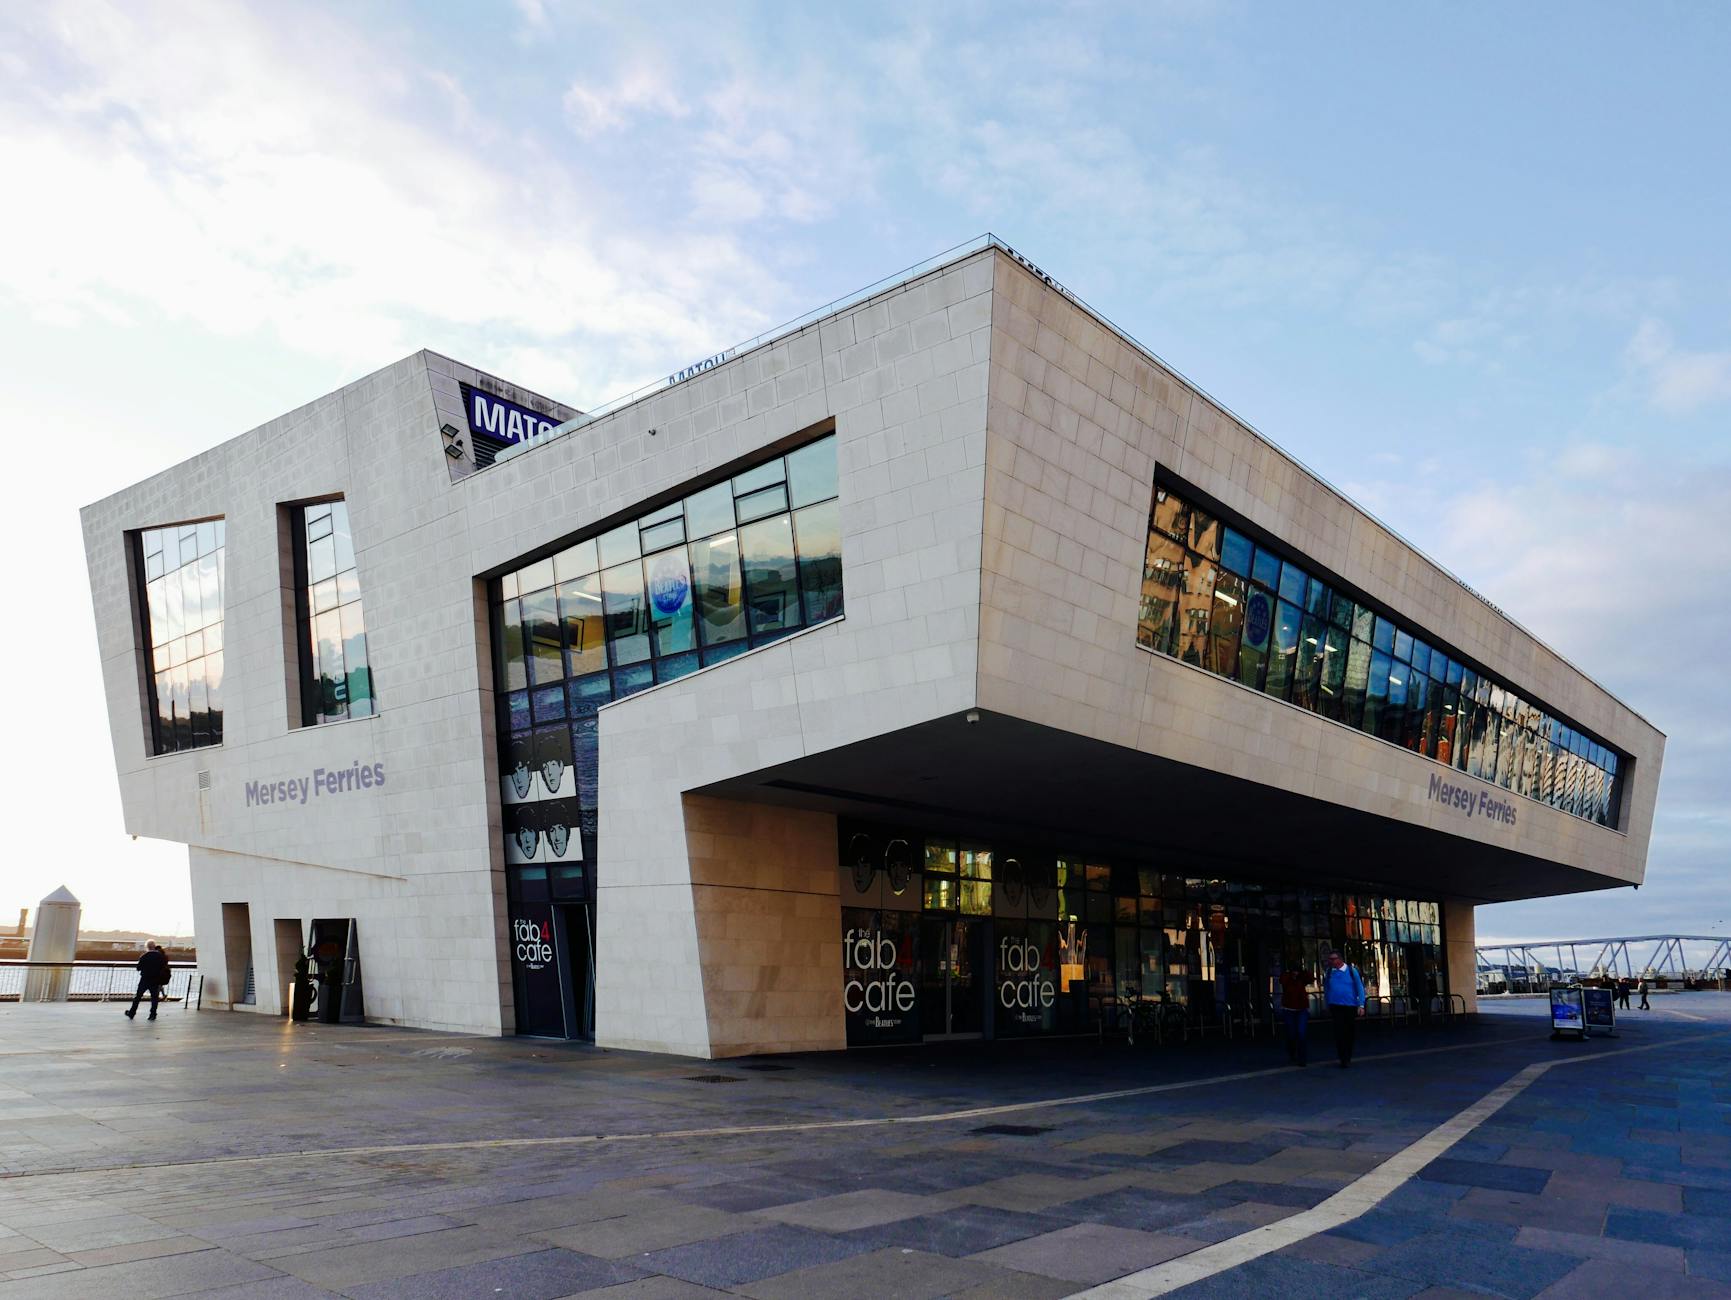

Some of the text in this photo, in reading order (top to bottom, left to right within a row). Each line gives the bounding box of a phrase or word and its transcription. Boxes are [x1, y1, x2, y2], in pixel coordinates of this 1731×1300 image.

[245, 760, 386, 807] Mersey Ferries
[1428, 773, 1518, 825] Mersey Ferries
[516, 939, 552, 963] cafe
[844, 971, 916, 1013] cafe
[1001, 973, 1055, 1009] cafe
